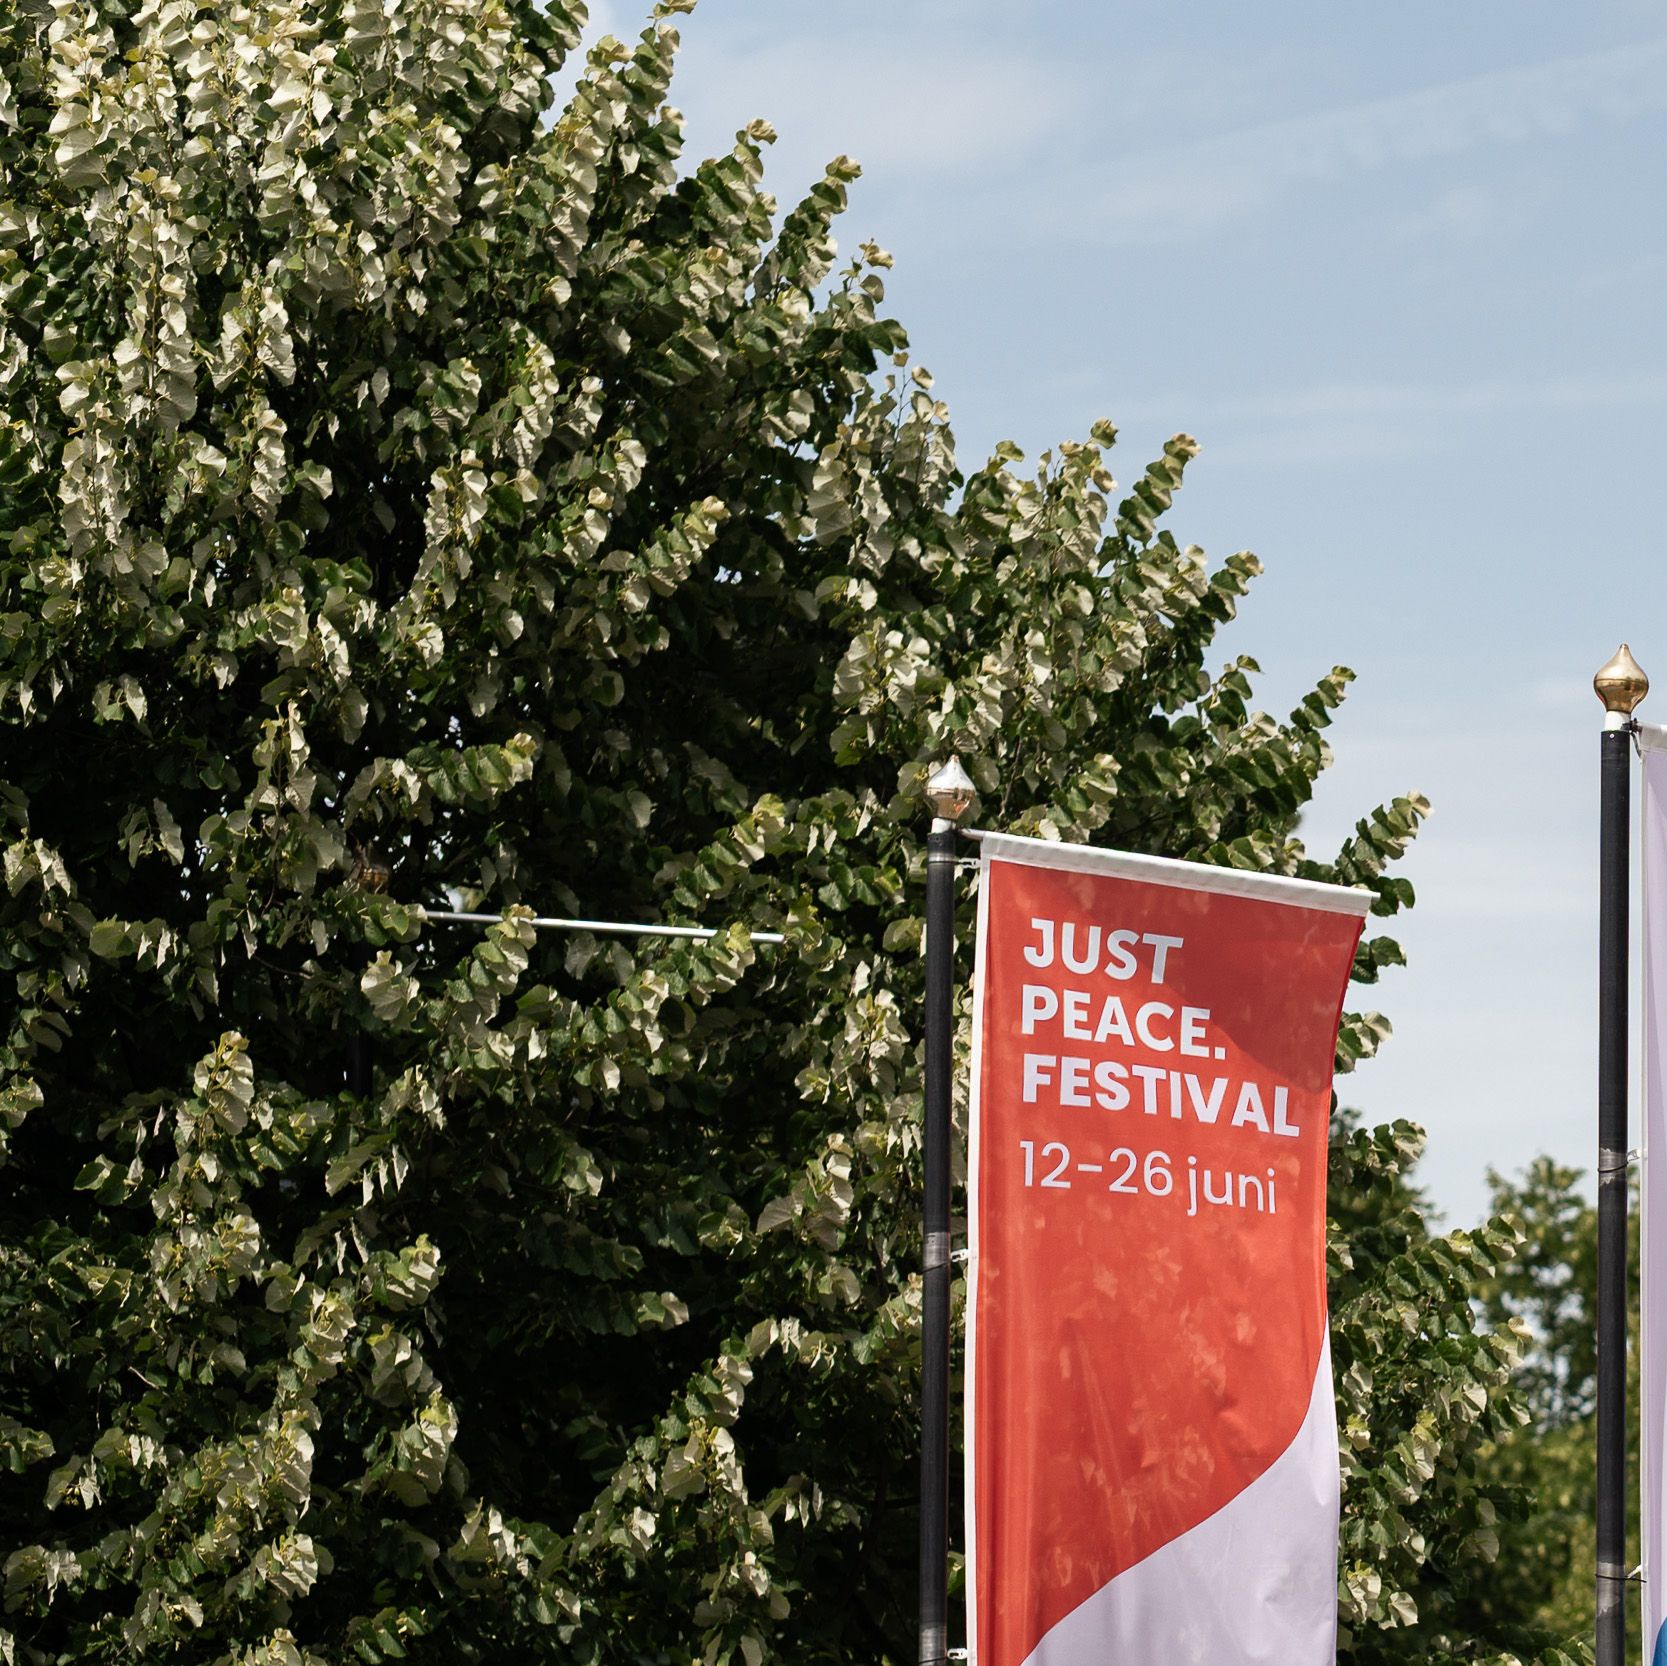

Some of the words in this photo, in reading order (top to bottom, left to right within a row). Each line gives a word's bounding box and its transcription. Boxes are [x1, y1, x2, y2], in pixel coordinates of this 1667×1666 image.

[1023, 918, 1184, 984] JUST
[1022, 984, 1226, 1061] PEACE.
[1023, 1053, 1300, 1137] FESTIVAL
[1187, 1156, 1276, 1217] juni
